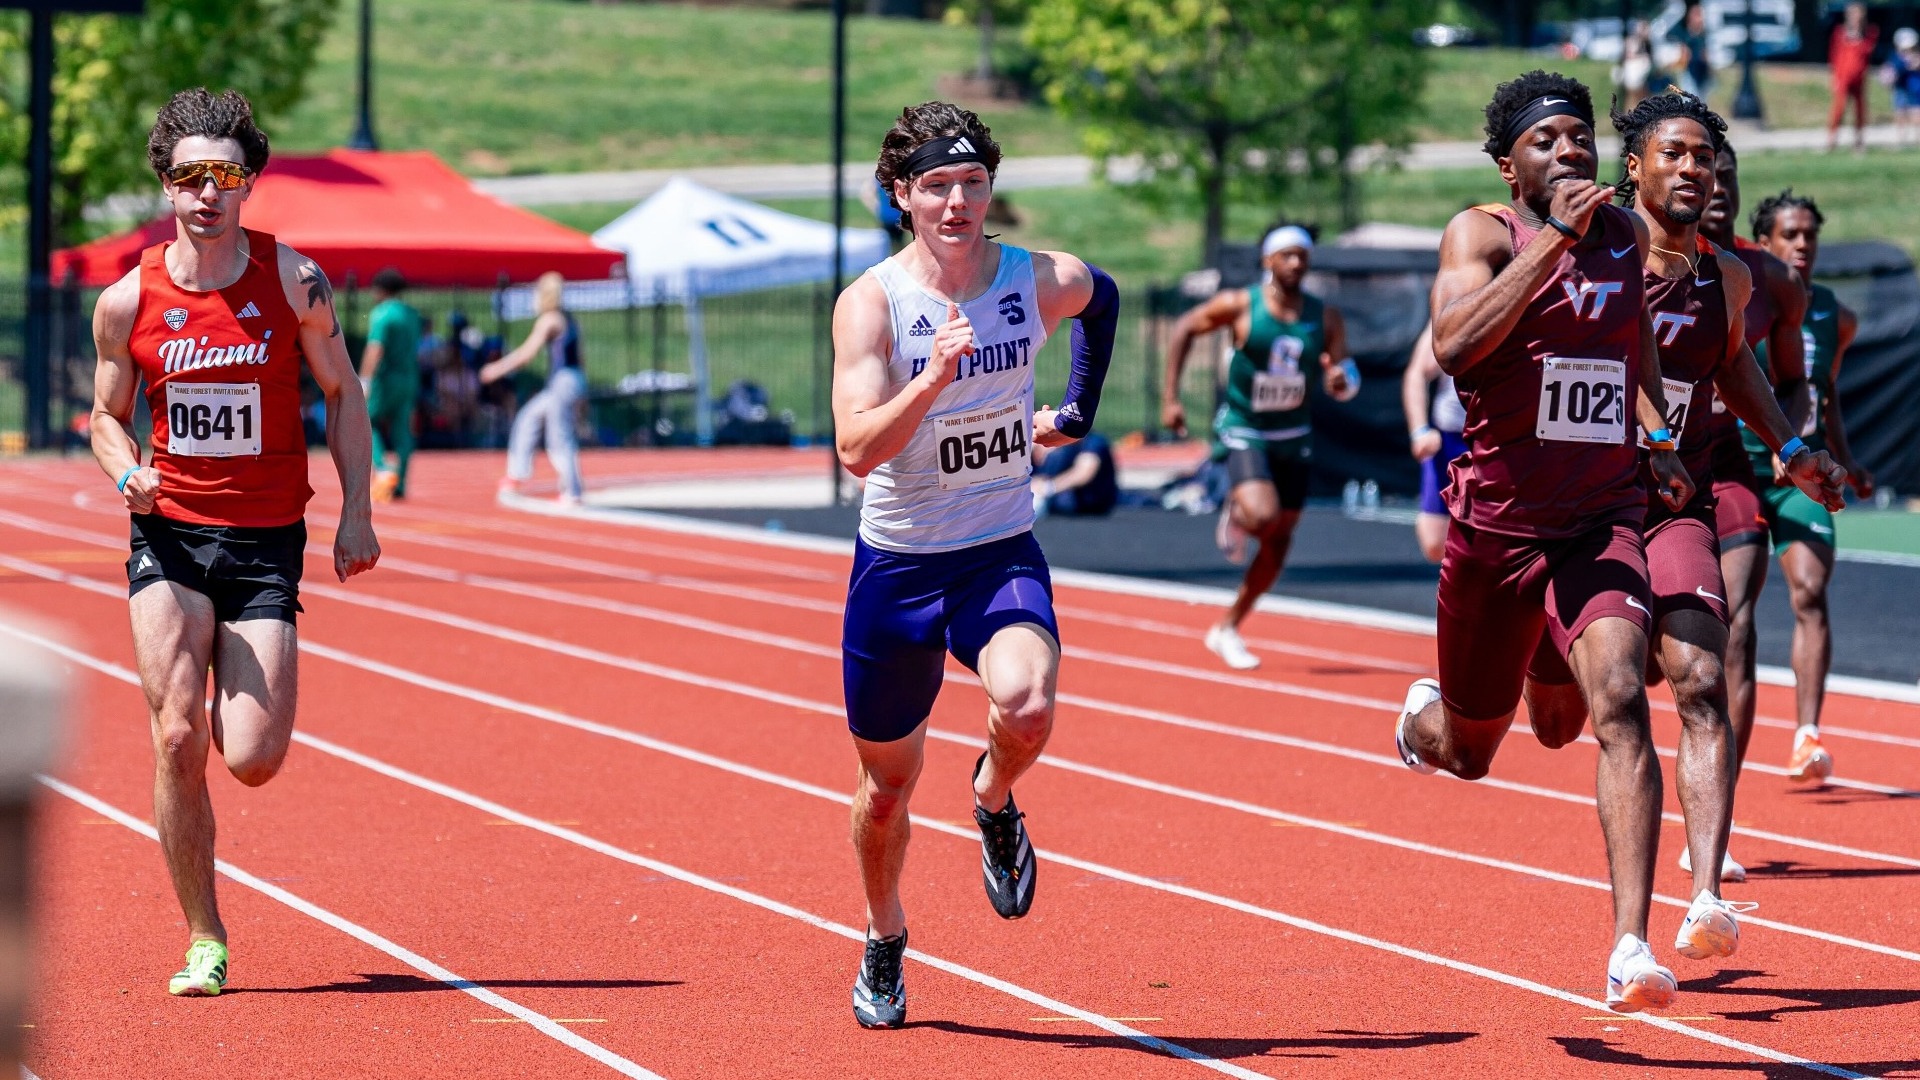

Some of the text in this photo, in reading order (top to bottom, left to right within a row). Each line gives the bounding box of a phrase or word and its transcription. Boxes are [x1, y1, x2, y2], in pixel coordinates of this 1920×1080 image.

[1561, 280, 1624, 320] VT
[158, 329, 273, 373] Miami
[909, 328, 936, 337] adidas
[968, 337, 1031, 378] POINT
[1555, 363, 1572, 371] WAKE
[174, 387, 190, 395] WAKE
[212, 388, 250, 396] INVITATIONAL
[1545, 381, 1624, 425] 1025
[170, 402, 252, 440] 0641
[944, 404, 1018, 428] WAKE FOREST INVITATIONAL
[1060, 407, 1084, 422] adidas
[939, 419, 1027, 474] 0544
